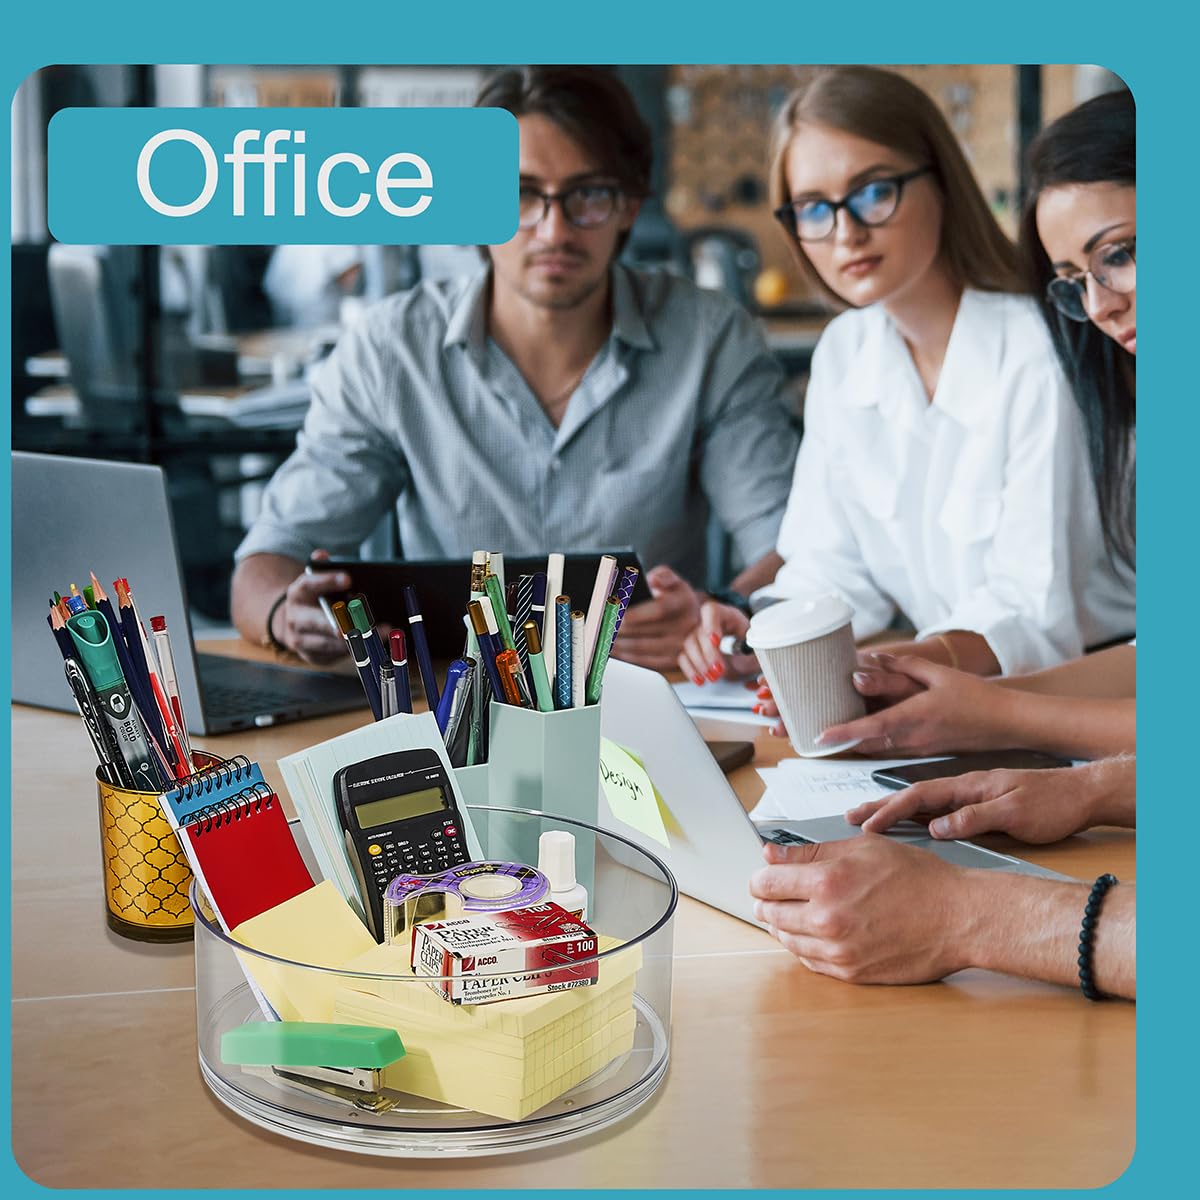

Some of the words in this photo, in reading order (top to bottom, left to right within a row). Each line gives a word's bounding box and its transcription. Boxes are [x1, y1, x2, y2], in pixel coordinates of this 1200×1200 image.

[123, 720, 137, 742] BOLD
[600, 758, 644, 800] Design
[525, 904, 552, 914] 100
[446, 919, 470, 927] ACCO
[434, 926, 495, 939] PAPER
[443, 930, 492, 944] CLIPS
[422, 934, 444, 966] PAPER
[576, 940, 594, 952] 100
[420, 950, 440, 974] CLIPS
[462, 974, 509, 991] PAPER
[548, 982, 566, 992] Stock
[464, 988, 492, 996] Trombones
